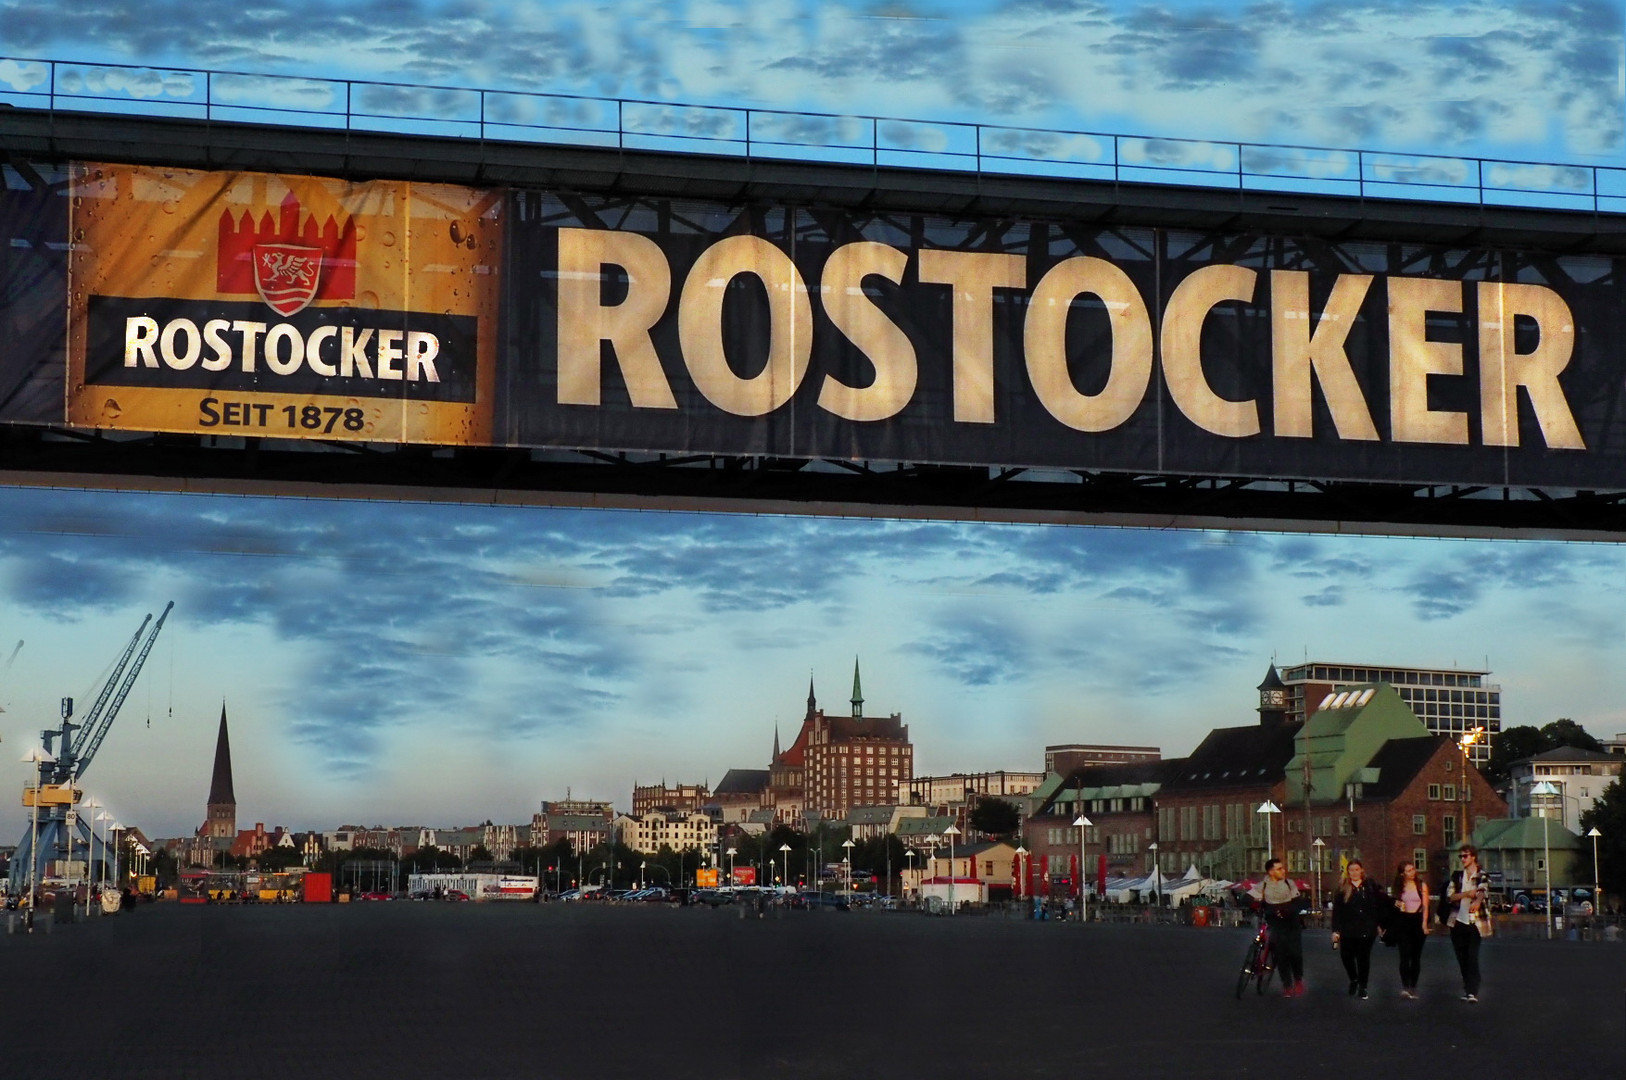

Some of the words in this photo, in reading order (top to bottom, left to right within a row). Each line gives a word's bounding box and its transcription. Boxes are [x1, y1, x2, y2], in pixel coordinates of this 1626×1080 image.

[124, 317, 441, 383] ROSTOCKER
[556, 227, 1586, 450] ROSTOCKER
[199, 397, 274, 427] SEIT
[281, 405, 365, 434] 1878
